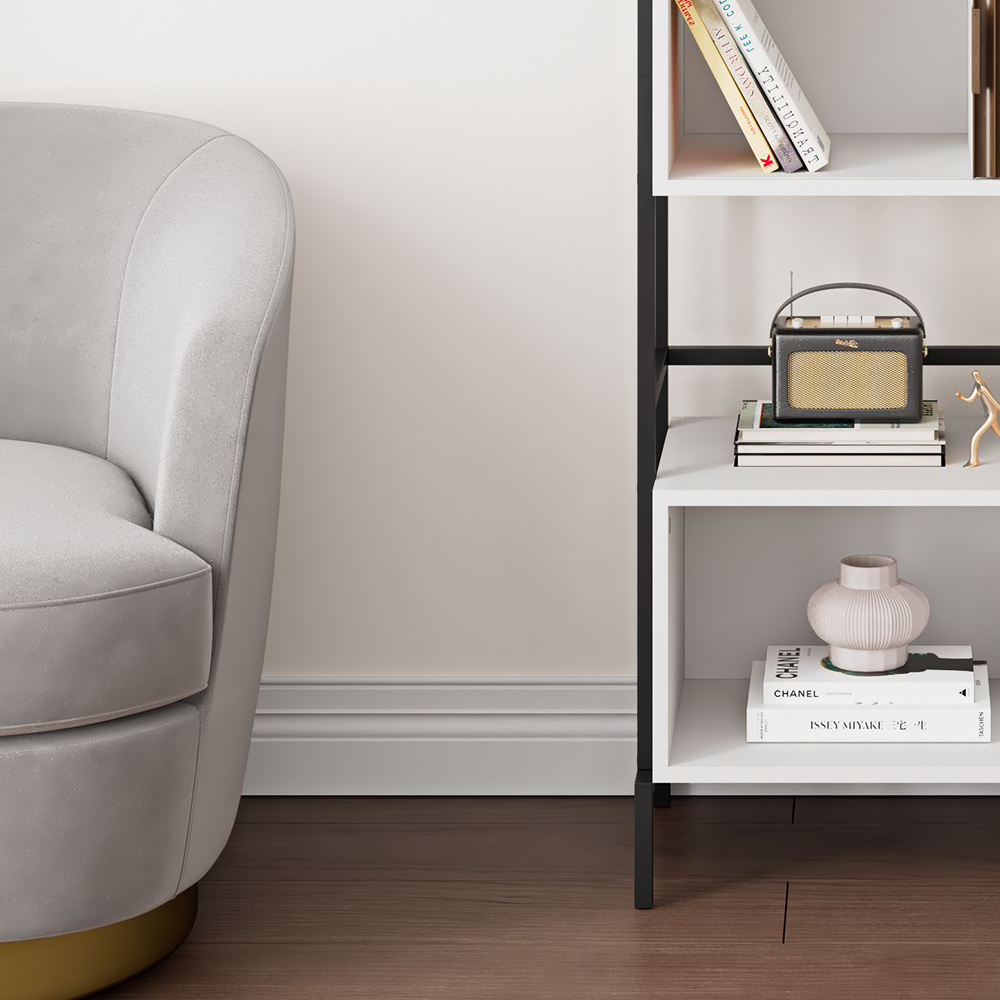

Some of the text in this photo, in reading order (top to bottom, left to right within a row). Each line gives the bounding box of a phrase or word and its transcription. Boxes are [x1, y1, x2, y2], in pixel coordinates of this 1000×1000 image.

[712, 28, 757, 97] AFTER DAYS
[764, 114, 779, 140] SCOTT
[775, 647, 801, 679] CHANEL
[774, 690, 819, 698] CHANEL
[810, 721, 883, 730] ISSEY MIYAKE
